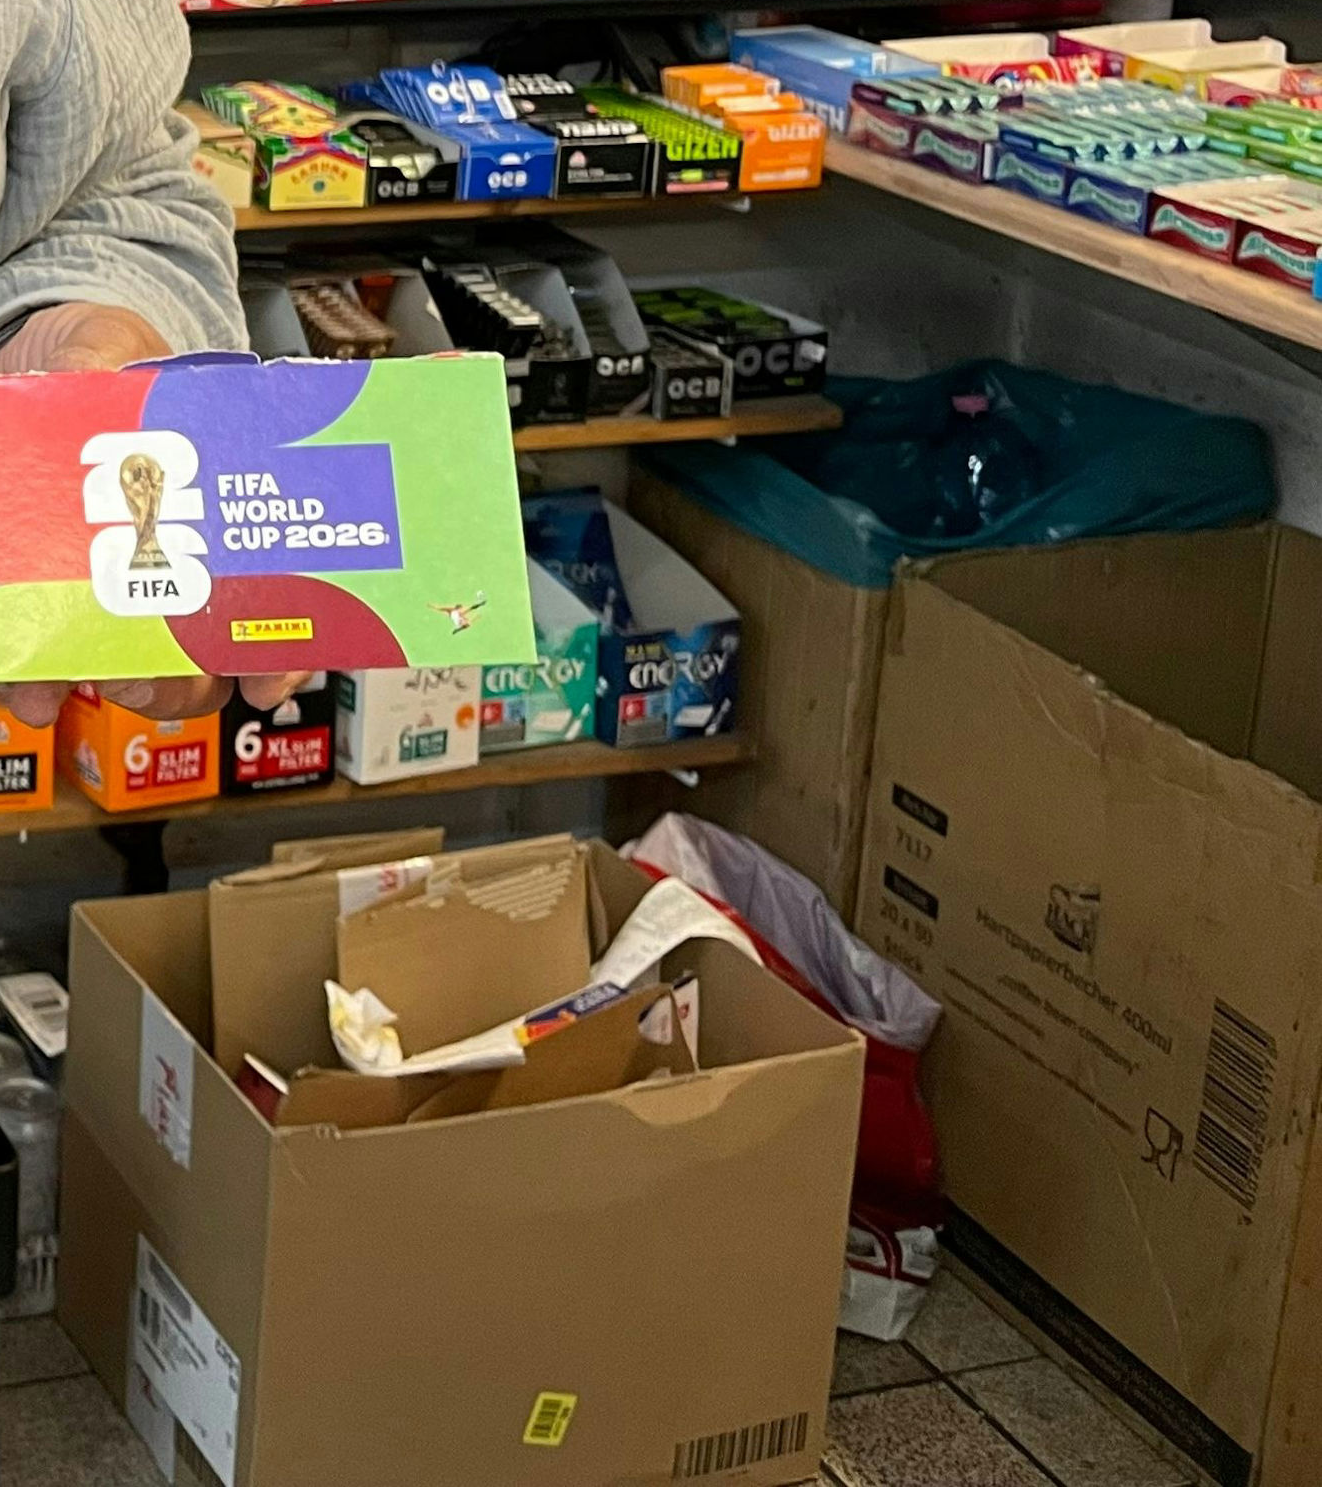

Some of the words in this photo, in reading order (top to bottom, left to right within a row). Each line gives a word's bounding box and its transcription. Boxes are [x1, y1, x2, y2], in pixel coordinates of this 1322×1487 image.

[426, 80, 489, 105] OCB
[217, 473, 280, 497] FIFA
[219, 499, 324, 523] WORLD
[223, 527, 280, 551] CUP
[285, 523, 385, 549] 2026
[127, 580, 179, 598] FIFA
[255, 623, 307, 632] PANINI
[158, 747, 201, 765] SLIM
[157, 765, 202, 782] FILTER
[1123, 1007, 1172, 1055] 400ml
